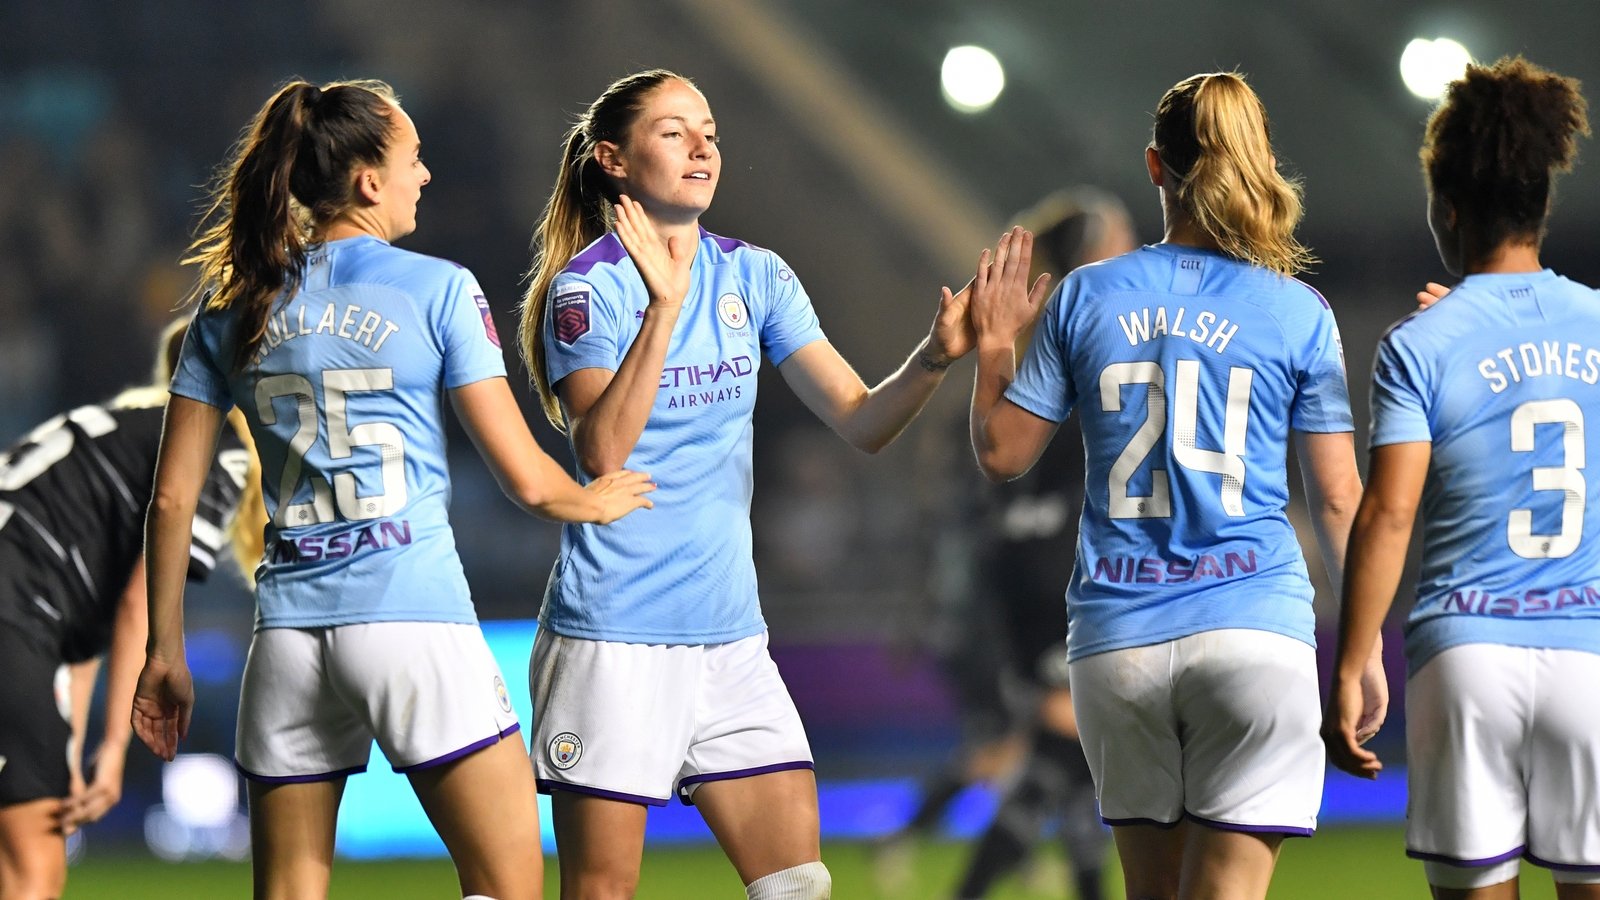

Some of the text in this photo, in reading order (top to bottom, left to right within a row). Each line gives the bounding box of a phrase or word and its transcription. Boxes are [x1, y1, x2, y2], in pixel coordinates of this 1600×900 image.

[1181, 259, 1201, 270] CITY
[1117, 306, 1239, 354] WALSH
[1477, 339, 1600, 395] STOKES
[667, 385, 742, 409] AIRWAYS
[254, 367, 409, 529] 25
[1099, 358, 1254, 519] 24
[1506, 397, 1587, 560] 3
[1092, 549, 1258, 584] NISSAN
